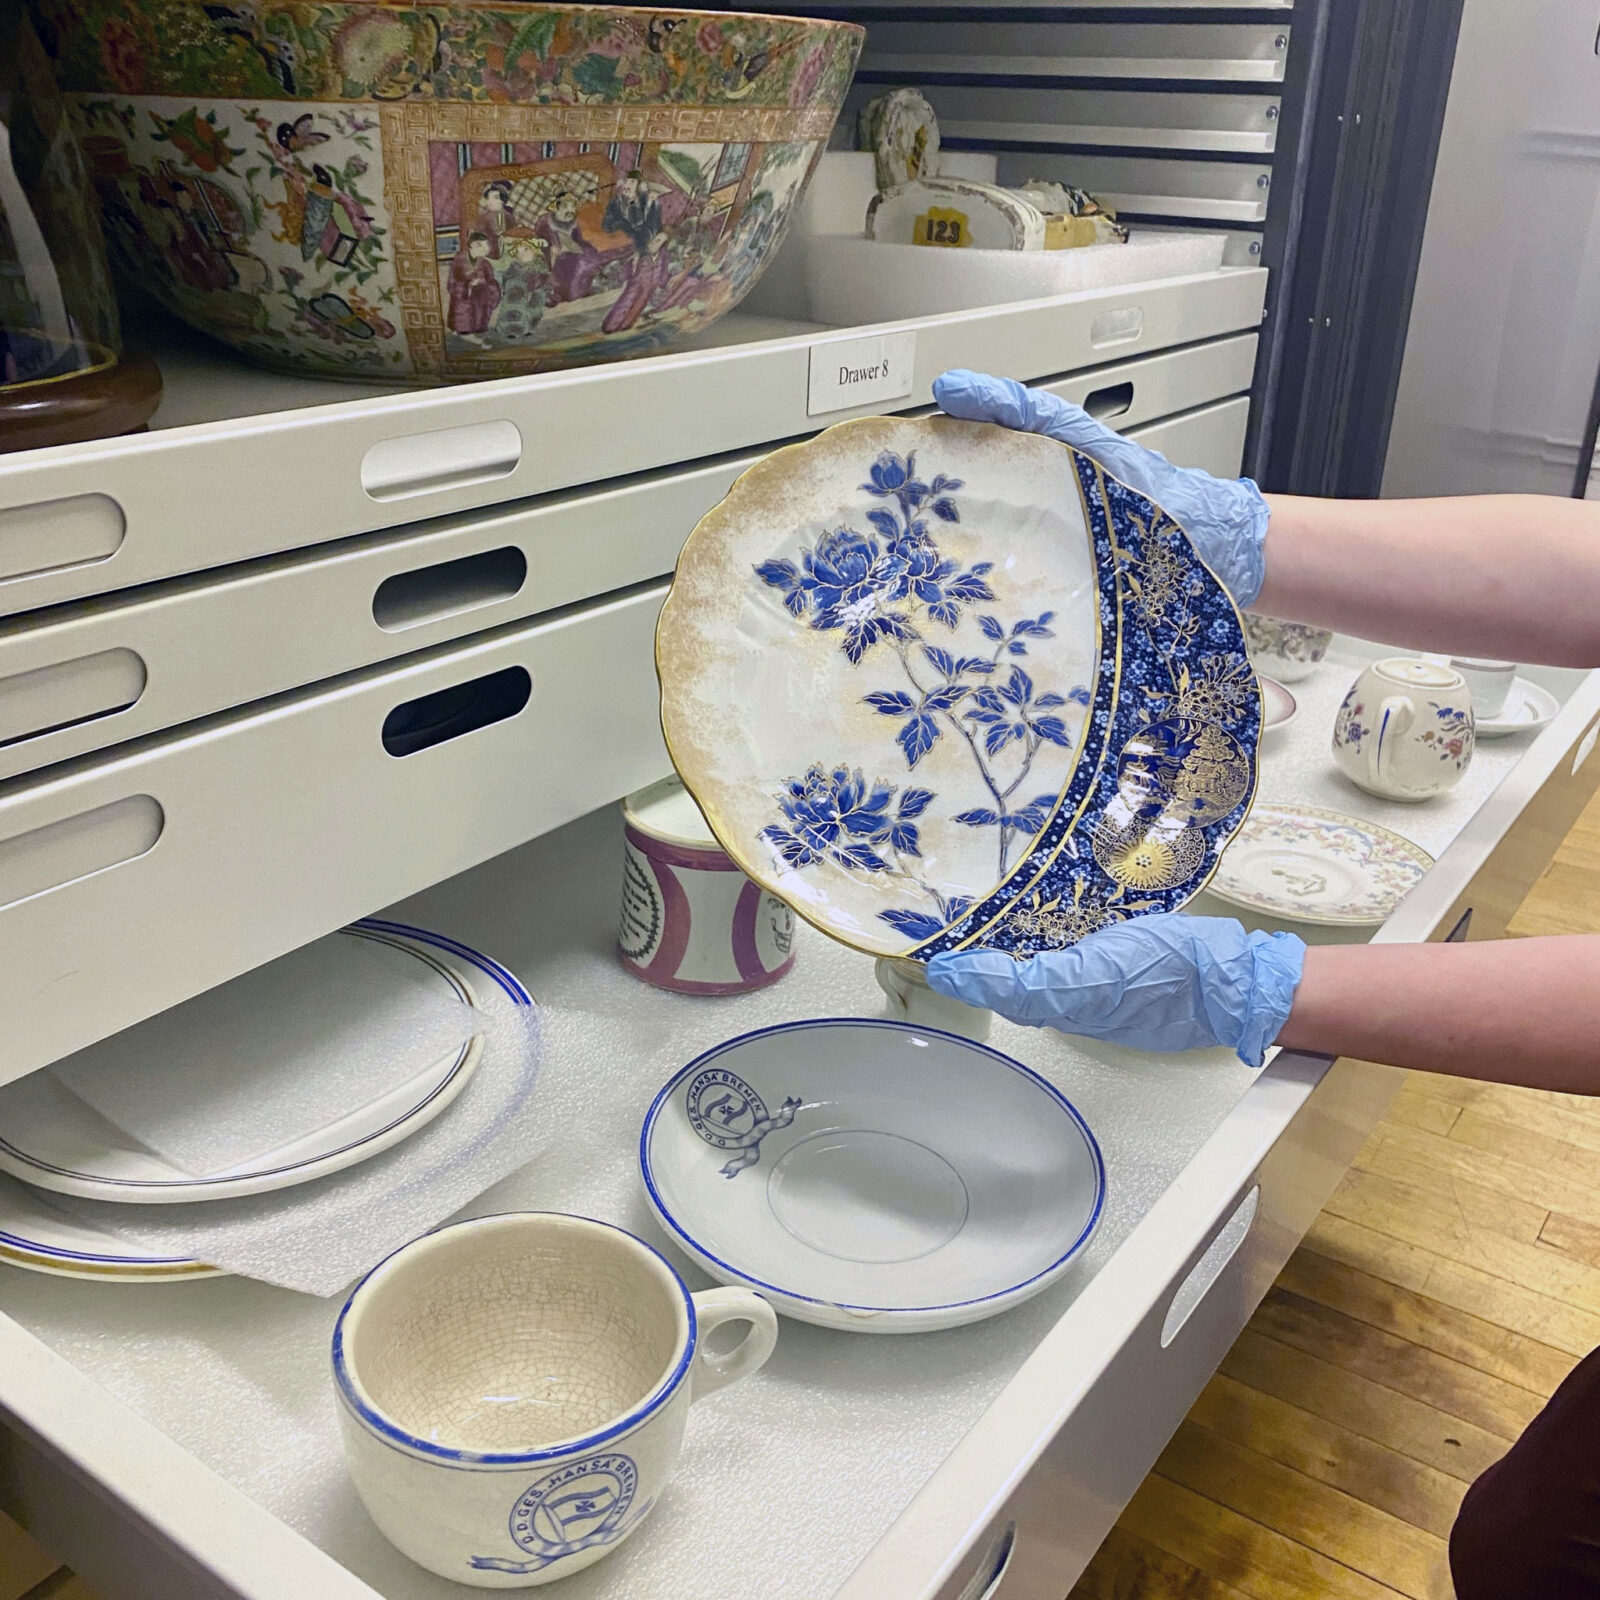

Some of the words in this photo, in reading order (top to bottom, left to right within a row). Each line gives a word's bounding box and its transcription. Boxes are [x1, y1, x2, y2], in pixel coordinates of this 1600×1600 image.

[927, 219, 961, 244] 123
[839, 366, 879, 385] Drawer
[882, 359, 889, 378] 8
[722, 1073, 762, 1112] BREMEN
[615, 1461, 634, 1515] BREMEN
